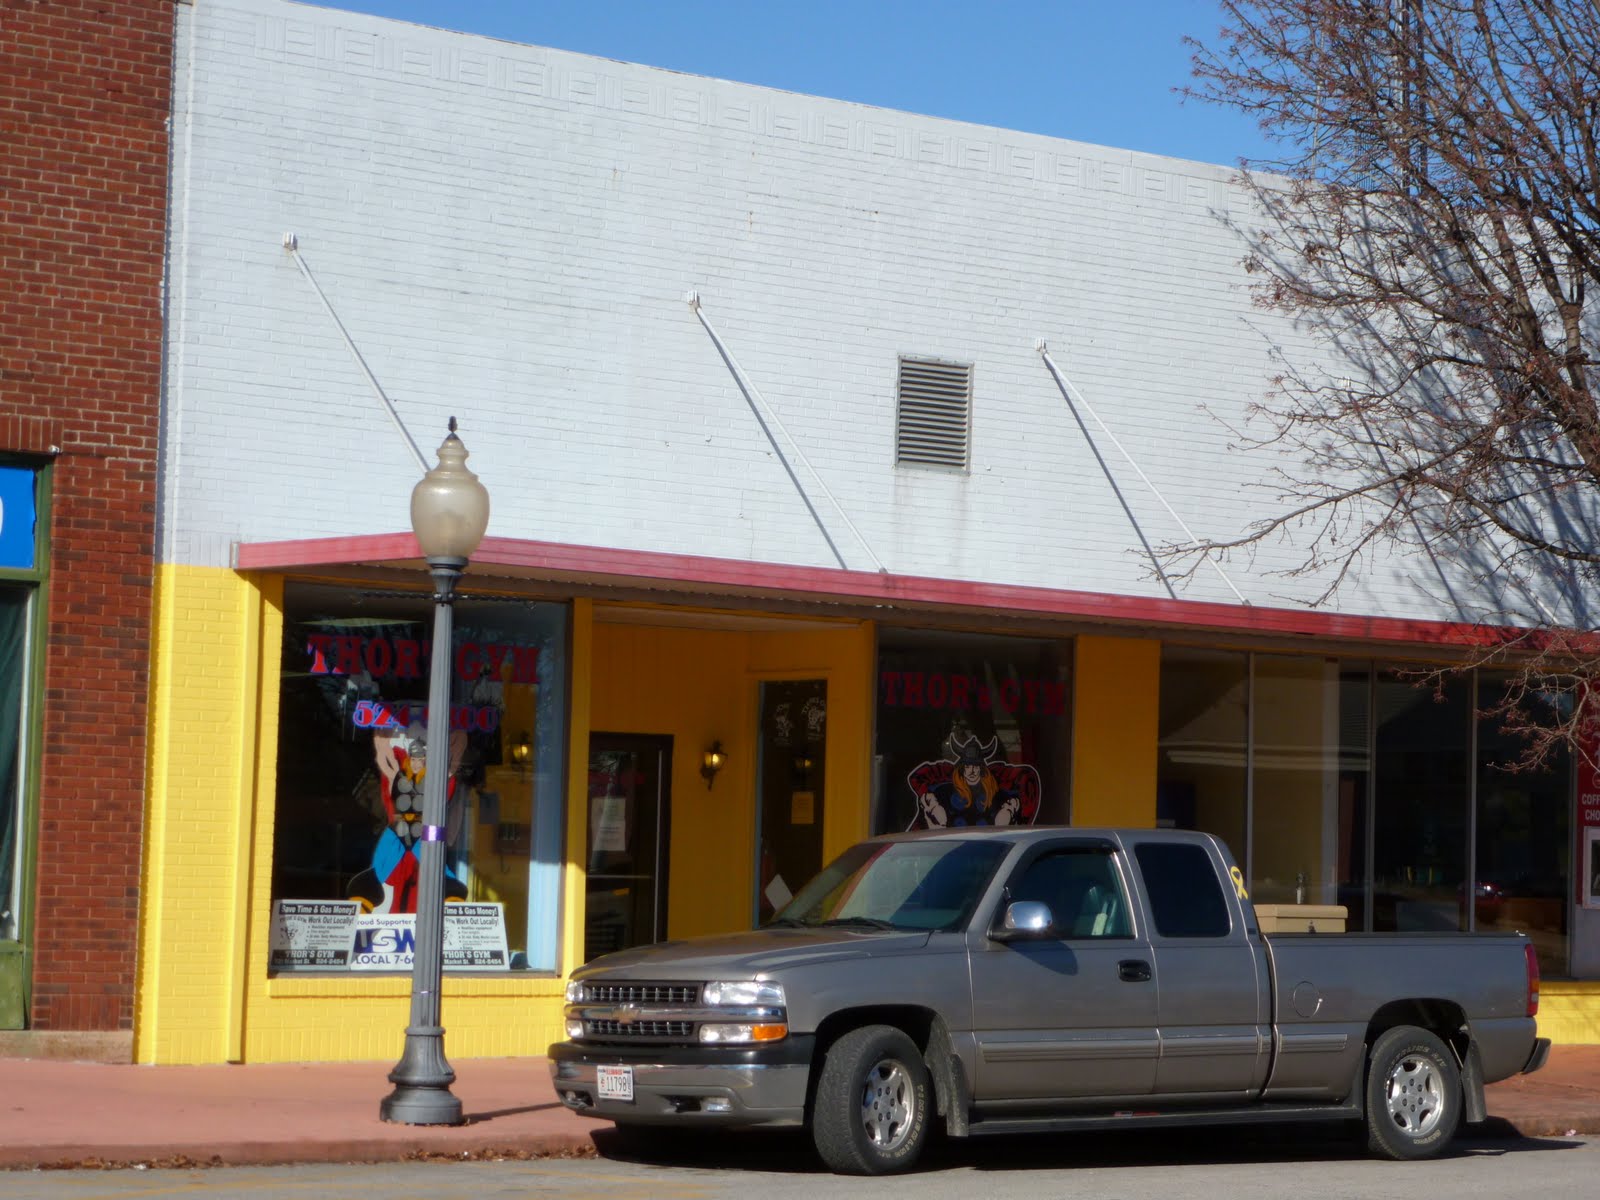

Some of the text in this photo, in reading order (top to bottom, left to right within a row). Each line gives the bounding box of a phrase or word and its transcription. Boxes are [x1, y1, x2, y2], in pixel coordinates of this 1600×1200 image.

[307, 634, 541, 683] THOR' GYM
[1001, 678, 1066, 715] GYM
[281, 904, 355, 915] Save Time & Gas Money!
[477, 907, 497, 916] Money!
[333, 917, 354, 926] Locally!
[376, 918, 412, 926] Supporter
[286, 950, 335, 958] THOR'S GYM
[443, 950, 472, 958] THOR'S
[355, 955, 391, 964] LOCAL
[607, 1076, 627, 1092] 11798
